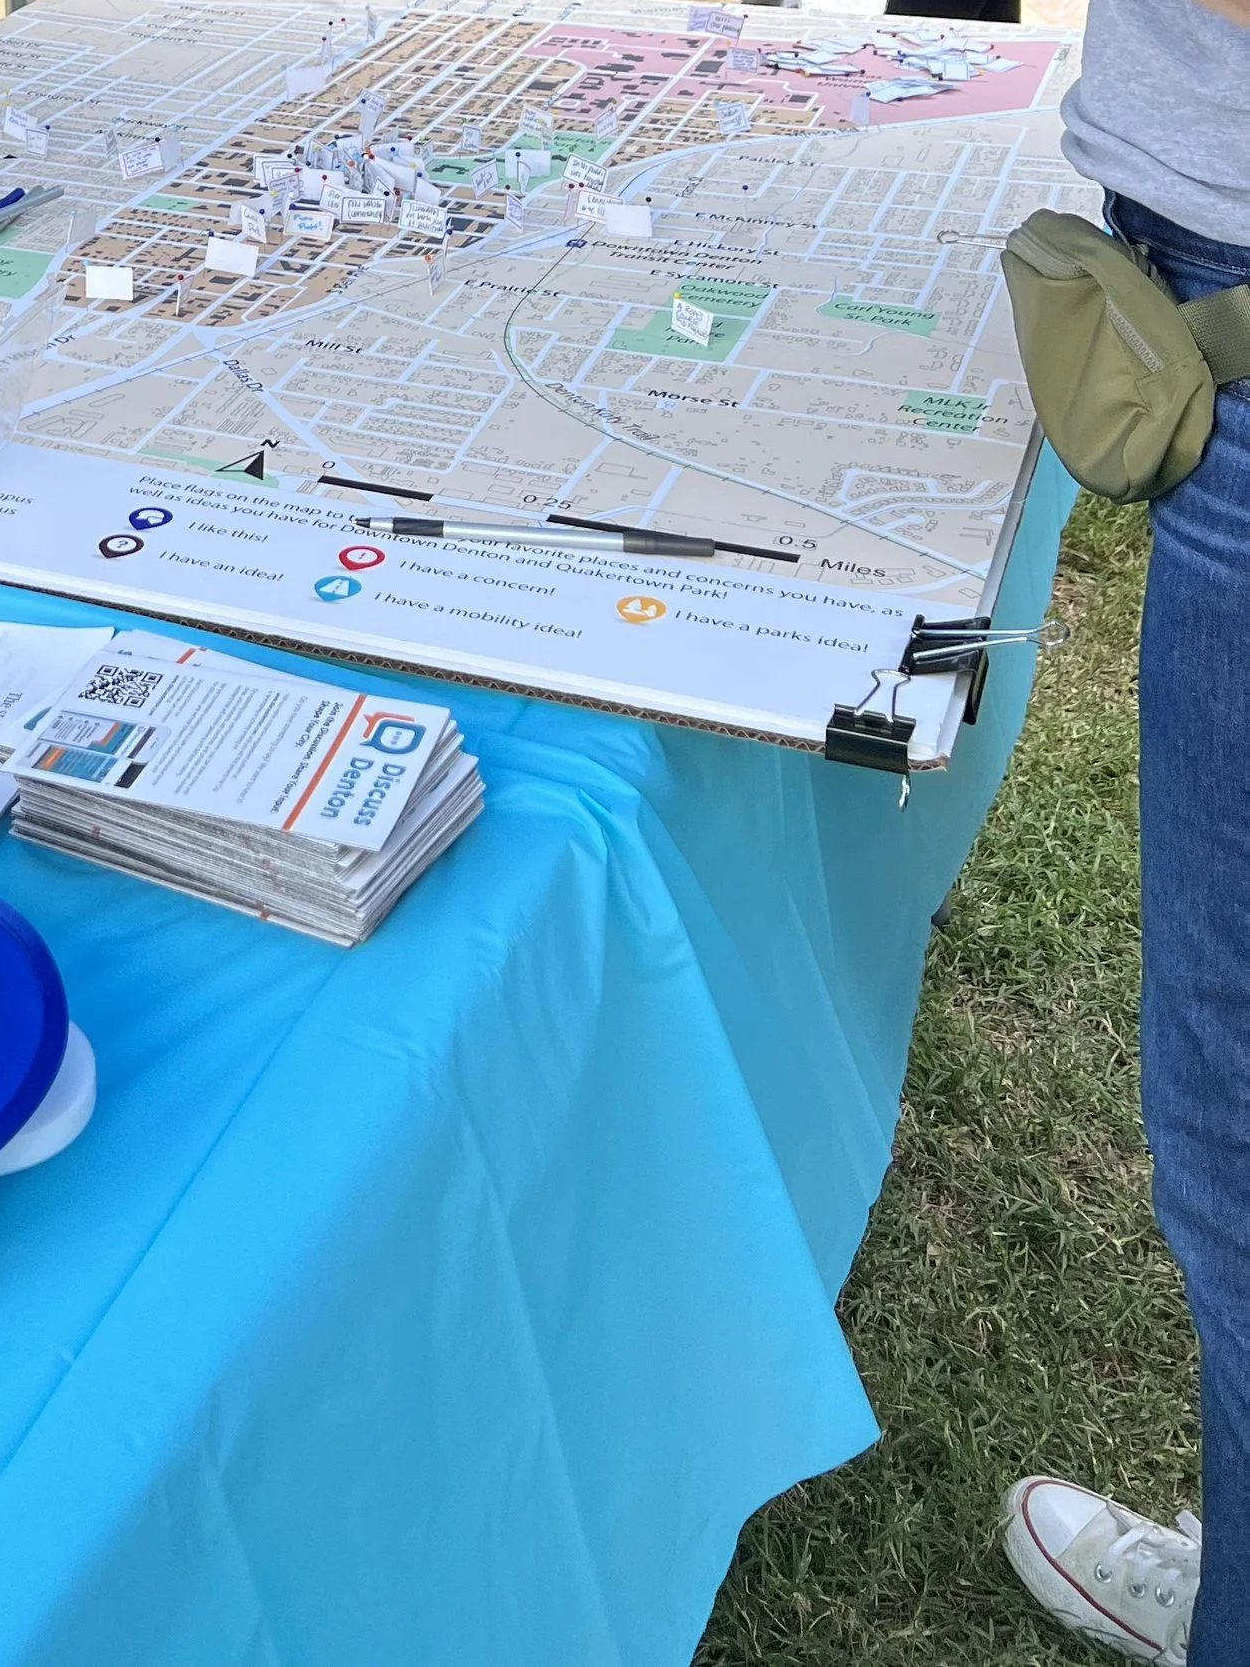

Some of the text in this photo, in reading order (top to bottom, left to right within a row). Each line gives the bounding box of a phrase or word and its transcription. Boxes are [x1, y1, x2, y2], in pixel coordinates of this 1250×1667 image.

[739, 155, 792, 167] Paisley
[710, 212, 802, 229] McKinney
[592, 240, 762, 265] Downtown Denton
[689, 240, 758, 256] Hickory
[610, 252, 735, 271] Transit Center
[479, 280, 544, 296] Prairie
[667, 271, 761, 288] Sycamore
[681, 284, 769, 301] Oakwood
[834, 302, 935, 320] Carl Young
[871, 314, 912, 328] Park
[306, 338, 363, 355] Mill St
[223, 358, 253, 385] Dallas
[648, 389, 741, 409] Morse St
[923, 395, 972, 411] MLK
[544, 382, 660, 441] Denton Trail
[898, 404, 1008, 425] Recreation
[912, 417, 981, 433] Center
[138, 475, 345, 520] Place flags on the map to
[523, 493, 572, 511] 0.25
[129, 485, 729, 600] well as ideas you have for Downtown Denton Quakertown Park!
[199, 524, 269, 544] like this!
[778, 535, 887, 578] 0.5 Miles
[170, 552, 285, 582] have an idea!
[410, 562, 452, 580] have
[474, 574, 556, 596] concern!
[580, 555, 903, 617] places and concerns you have, as
[384, 593, 430, 612] have
[448, 605, 530, 631] mobility
[534, 622, 584, 639] idea!
[685, 610, 734, 630] have
[755, 625, 813, 643] parks
[818, 635, 869, 654] idea!
[1, 692, 23, 709] The
[317, 756, 375, 820] Denton
[351, 762, 407, 828] Discuss
